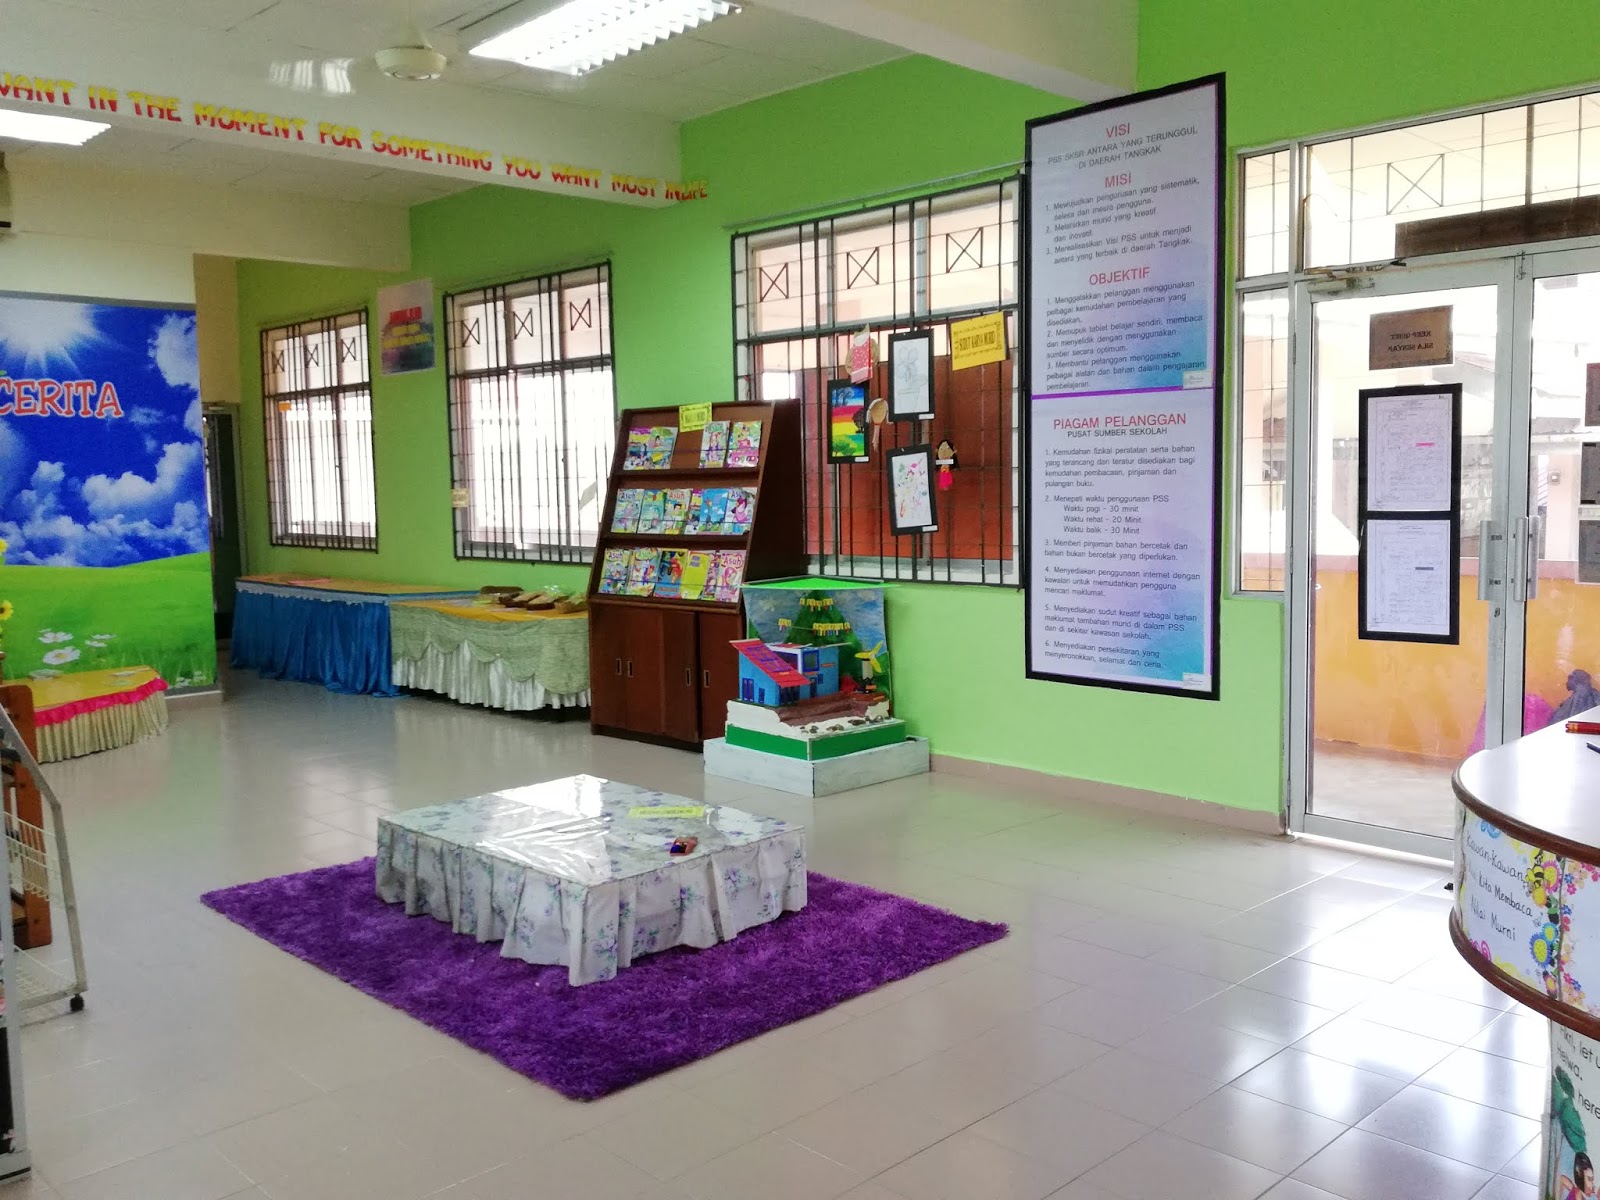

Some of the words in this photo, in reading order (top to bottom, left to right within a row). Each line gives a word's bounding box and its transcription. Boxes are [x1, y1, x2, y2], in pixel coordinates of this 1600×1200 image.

[1106, 123, 1130, 138] VISI
[88, 84, 118, 112] IN
[127, 91, 182, 121] THE
[194, 101, 308, 141] MOMENT
[318, 121, 362, 150] FOR
[371, 129, 493, 172] SOMETHING
[501, 155, 542, 180] YOU
[550, 162, 601, 189] WANT
[610, 173, 657, 199] MOST
[1088, 143, 1118, 155] ANTARA
[1120, 137, 1143, 149] YANG
[1146, 126, 1197, 144] TERUNGGUL
[1079, 161, 1087, 169] DI
[1089, 154, 1120, 167] DAERAH
[1124, 145, 1161, 159] TANGKAK
[1105, 172, 1132, 188] MISI
[1053, 197, 1094, 210] Mewujudkan
[1096, 190, 1137, 202] pengurusan
[1140, 184, 1157, 195] yang
[1054, 212, 1074, 221] selesa
[1077, 208, 1090, 217] dan
[1093, 204, 1113, 213] mesra
[1093, 215, 1111, 225] murid
[1115, 212, 1131, 222] yang
[1054, 234, 1066, 242] dan
[1106, 236, 1118, 244] Visi
[1121, 234, 1136, 243] PSS
[1140, 230, 1159, 240] untuk
[1163, 225, 1192, 237] menjadi
[1077, 253, 1093, 263] yang
[1095, 247, 1118, 258] terbaik
[1131, 242, 1156, 253] daerah
[1089, 267, 1150, 285] OBJEKTIF
[1055, 293, 1101, 305] Menggalakkan
[1104, 287, 1140, 298] pelanggan
[1143, 280, 1195, 292] menggunakan
[1047, 305, 1074, 316] pelbagai
[1076, 301, 1114, 312] kemudahan
[1117, 295, 1165, 309] pembelajaran
[1168, 292, 1186, 301] yang
[1056, 326, 1086, 336] Memupuk
[1111, 320, 1134, 330] belajar
[1166, 314, 1203, 325] membaca
[1047, 340, 1058, 348] dan
[1061, 335, 1094, 347] menyelidik
[1097, 334, 1122, 344] dengan
[1126, 328, 1176, 340] menggunakan
[1047, 350, 1069, 359] sumber
[1073, 347, 1093, 356] secara
[1055, 358, 1088, 368] Membantu
[1092, 355, 1127, 365] pelanggan
[1130, 351, 1180, 362] menggunakan
[1047, 370, 1073, 380] pelbagai
[1113, 365, 1134, 374] bahan
[1138, 362, 1159, 372] dalam
[1053, 417, 1099, 430] PIAGAM
[1105, 413, 1186, 427] PELANGGAN
[1068, 430, 1091, 438] PUSAT
[1094, 429, 1126, 437] SUMBER
[1130, 427, 1167, 435] SEKOLAH
[1053, 448, 1091, 456] Kemudahan
[1115, 446, 1148, 455] peralatan
[1172, 445, 1195, 453] bahan
[1045, 459, 1060, 467] yang
[1063, 458, 1094, 467] terancang
[1113, 457, 1134, 465] teratur
[1138, 457, 1176, 465] disediakan
[1179, 456, 1195, 466] bagi
[1128, 468, 1159, 477] pinjaman
[1045, 479, 1074, 488] pulangan
[669, 490, 685, 499] Asuh
[1054, 495, 1083, 504] Menepati
[1107, 495, 1150, 504] penggunaan
[1064, 515, 1084, 523] Waktu
[1125, 516, 1141, 524] Minit
[1053, 539, 1081, 547] Memberi
[1084, 540, 1113, 549] pinjaman
[1116, 541, 1137, 549] bahan
[1140, 542, 1171, 550] bercetak
[723, 557, 742, 566] Asuh
[1089, 551, 1116, 559] bercetak
[1119, 553, 1136, 561] yang
[1054, 566, 1095, 575] Menyediakan
[1098, 569, 1140, 578] penggunaan
[1143, 571, 1170, 579] internet
[1173, 573, 1200, 581] dengan
[1045, 576, 1070, 584] kawalan
[1093, 579, 1138, 588] memudahkan
[1141, 582, 1176, 591] pengguna
[1045, 587, 1069, 595] mencari
[1054, 604, 1095, 614] Menyediakan
[1098, 607, 1116, 616] sudut
[1119, 608, 1140, 617] kreatif
[1143, 611, 1171, 621] sebagai
[1175, 613, 1197, 621] bahan
[1045, 614, 1075, 623] maklumat
[1077, 616, 1110, 626] tambahan
[1112, 619, 1131, 627] murid
[1143, 621, 1165, 630] dalam
[1168, 623, 1184, 632] PSS
[1045, 624, 1057, 632] dan
[1068, 626, 1088, 634] sekitar
[1091, 628, 1120, 637] kawasan
[1054, 641, 1095, 651] Menyediakan
[1098, 645, 1139, 656] persekitaran
[1142, 650, 1160, 659] yang
[1099, 656, 1125, 665] selamat
[1128, 658, 1141, 666] dan
[1495, 885, 1533, 916] Membaca
[1491, 912, 1516, 940] Murni
[1580, 1041, 1593, 1062] let
